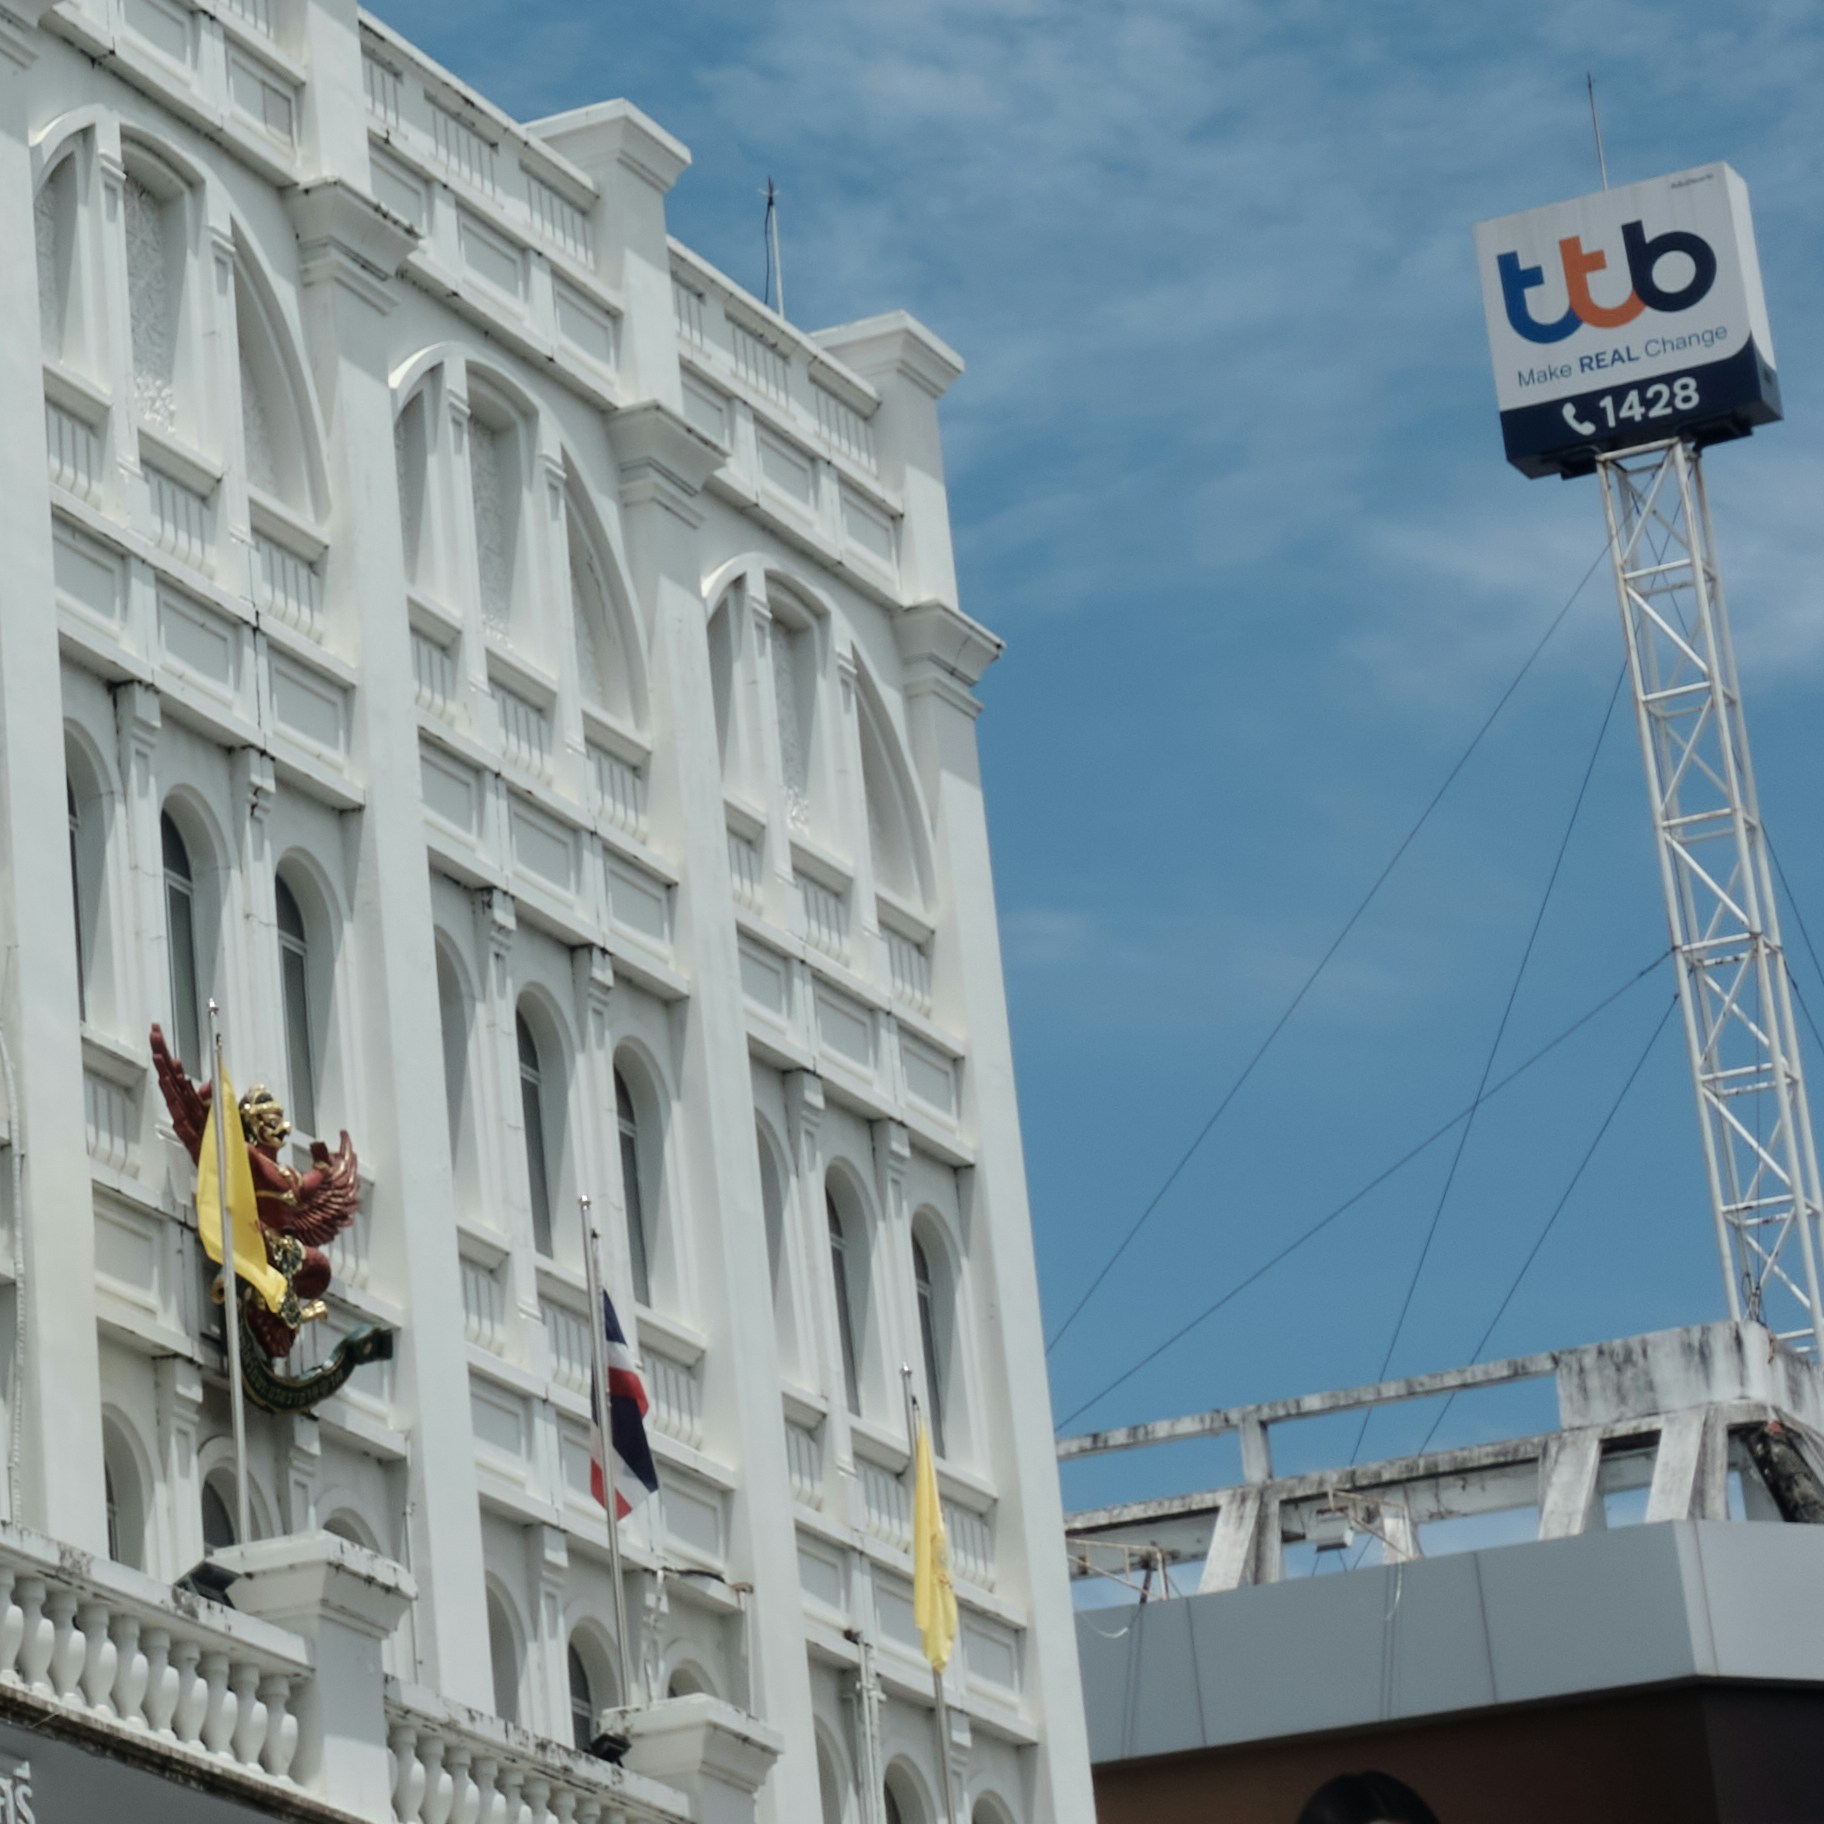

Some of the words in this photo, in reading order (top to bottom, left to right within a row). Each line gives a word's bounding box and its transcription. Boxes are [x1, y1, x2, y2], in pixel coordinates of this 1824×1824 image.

[1496, 218, 1718, 345] ttb
[1516, 361, 1573, 389] Make
[1578, 345, 1641, 375] REAL
[1643, 325, 1729, 360] Change
[1598, 375, 1701, 429] 1428
